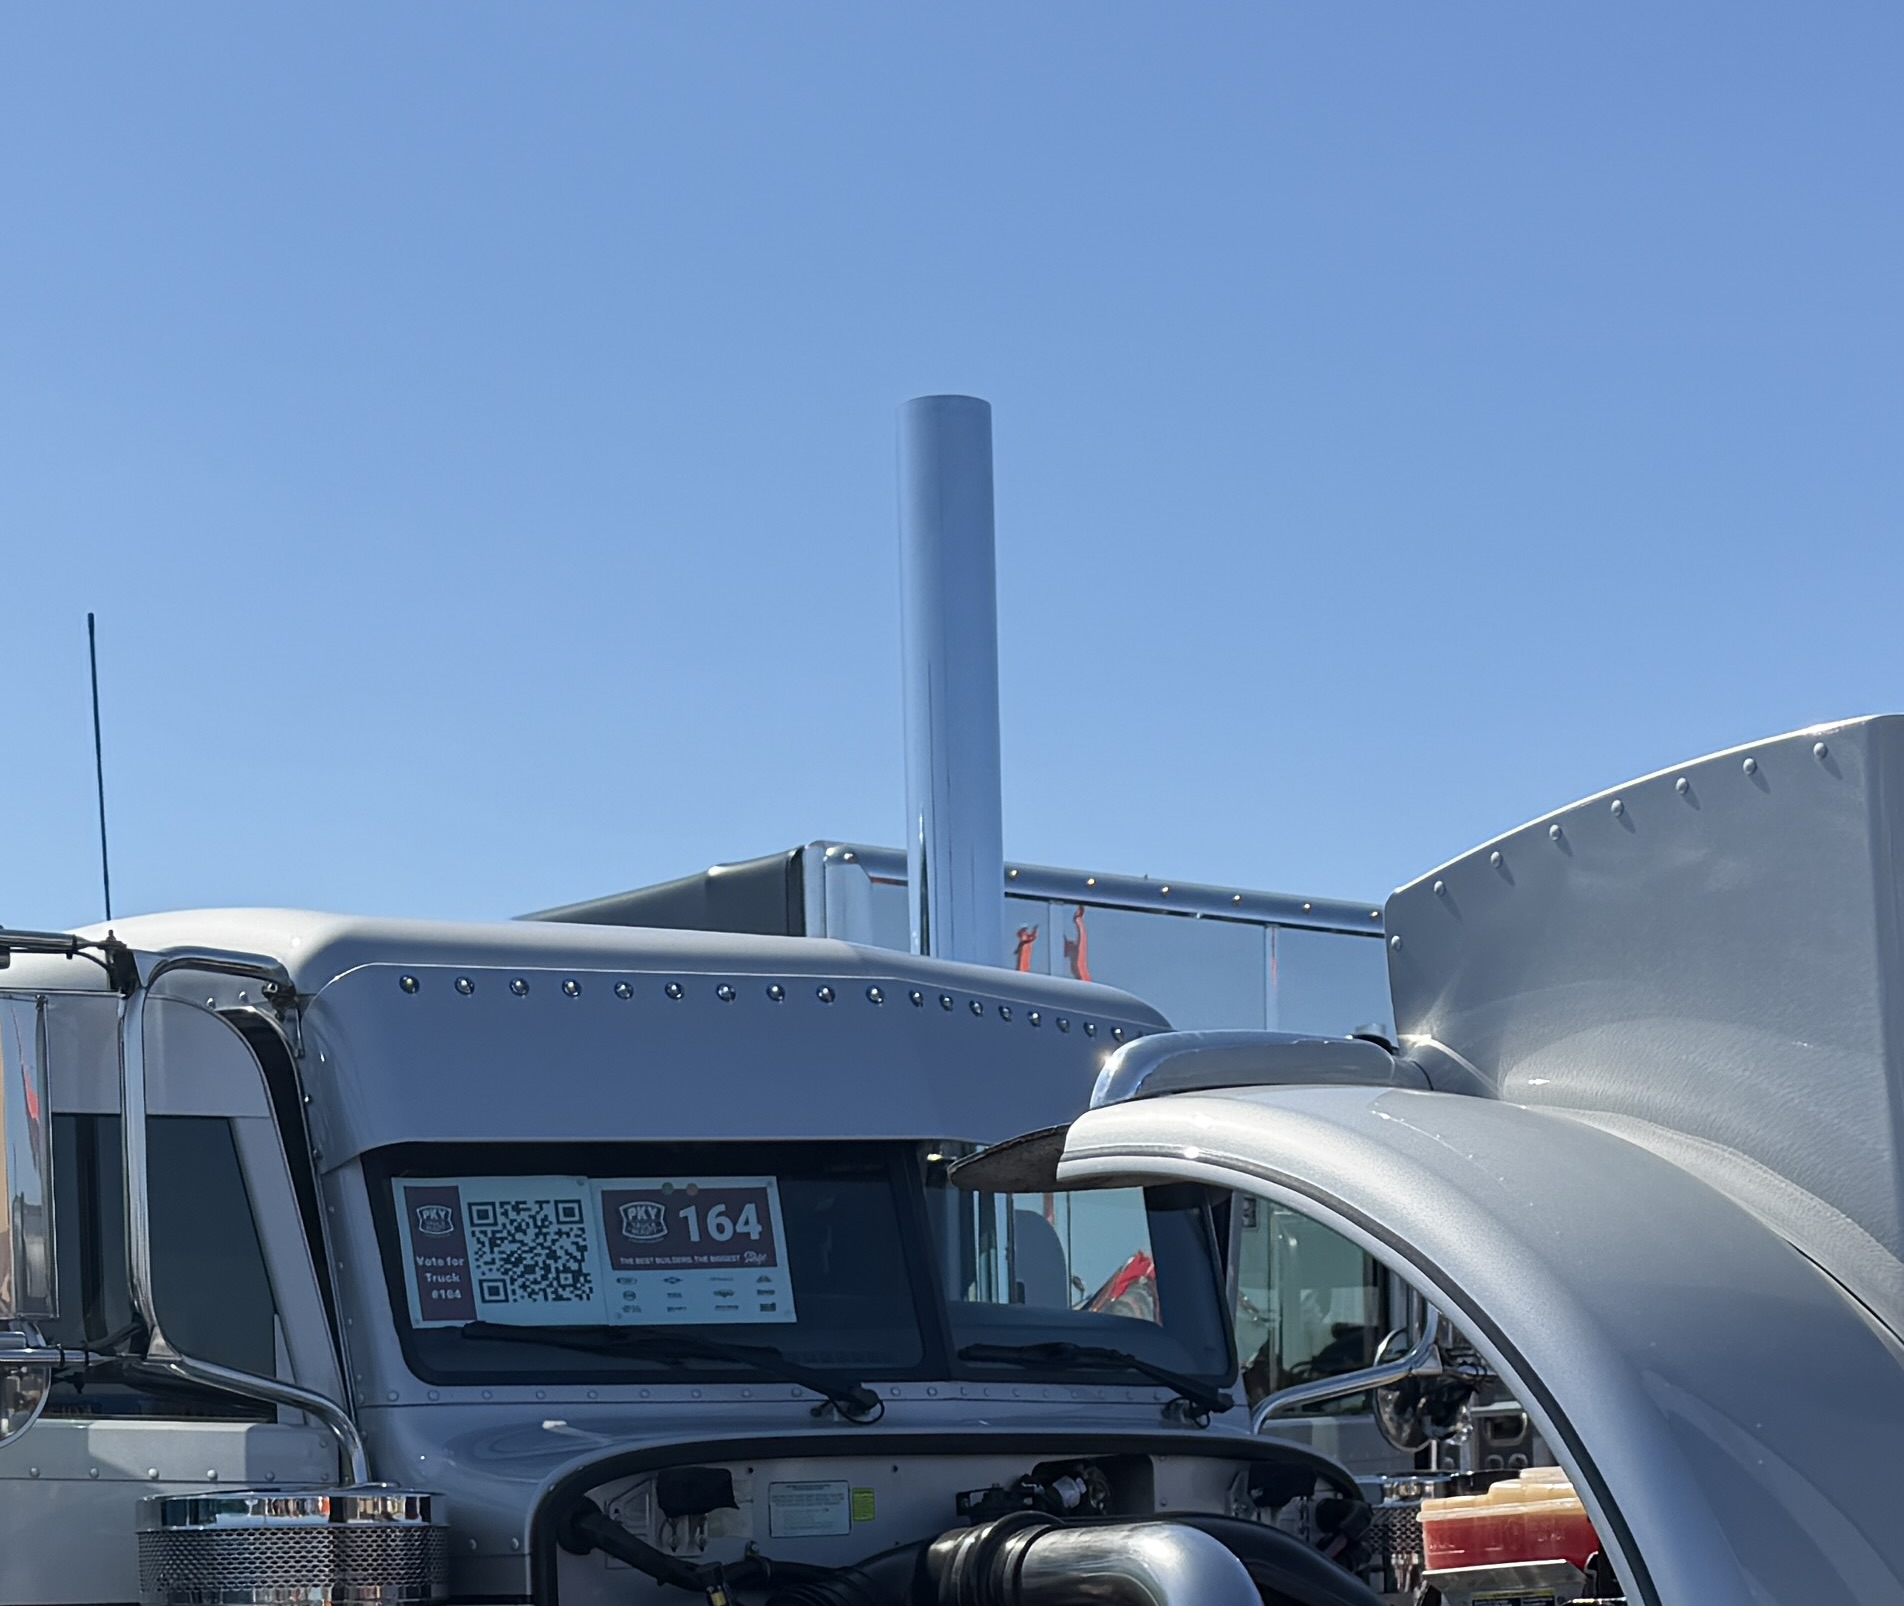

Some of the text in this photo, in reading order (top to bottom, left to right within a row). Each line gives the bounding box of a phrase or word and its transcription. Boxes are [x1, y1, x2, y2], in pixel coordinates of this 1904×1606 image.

[627, 1205, 659, 1221] PKY
[679, 1203, 763, 1242] 164
[416, 1256, 464, 1267] Vote for
[425, 1273, 461, 1283] Truck
